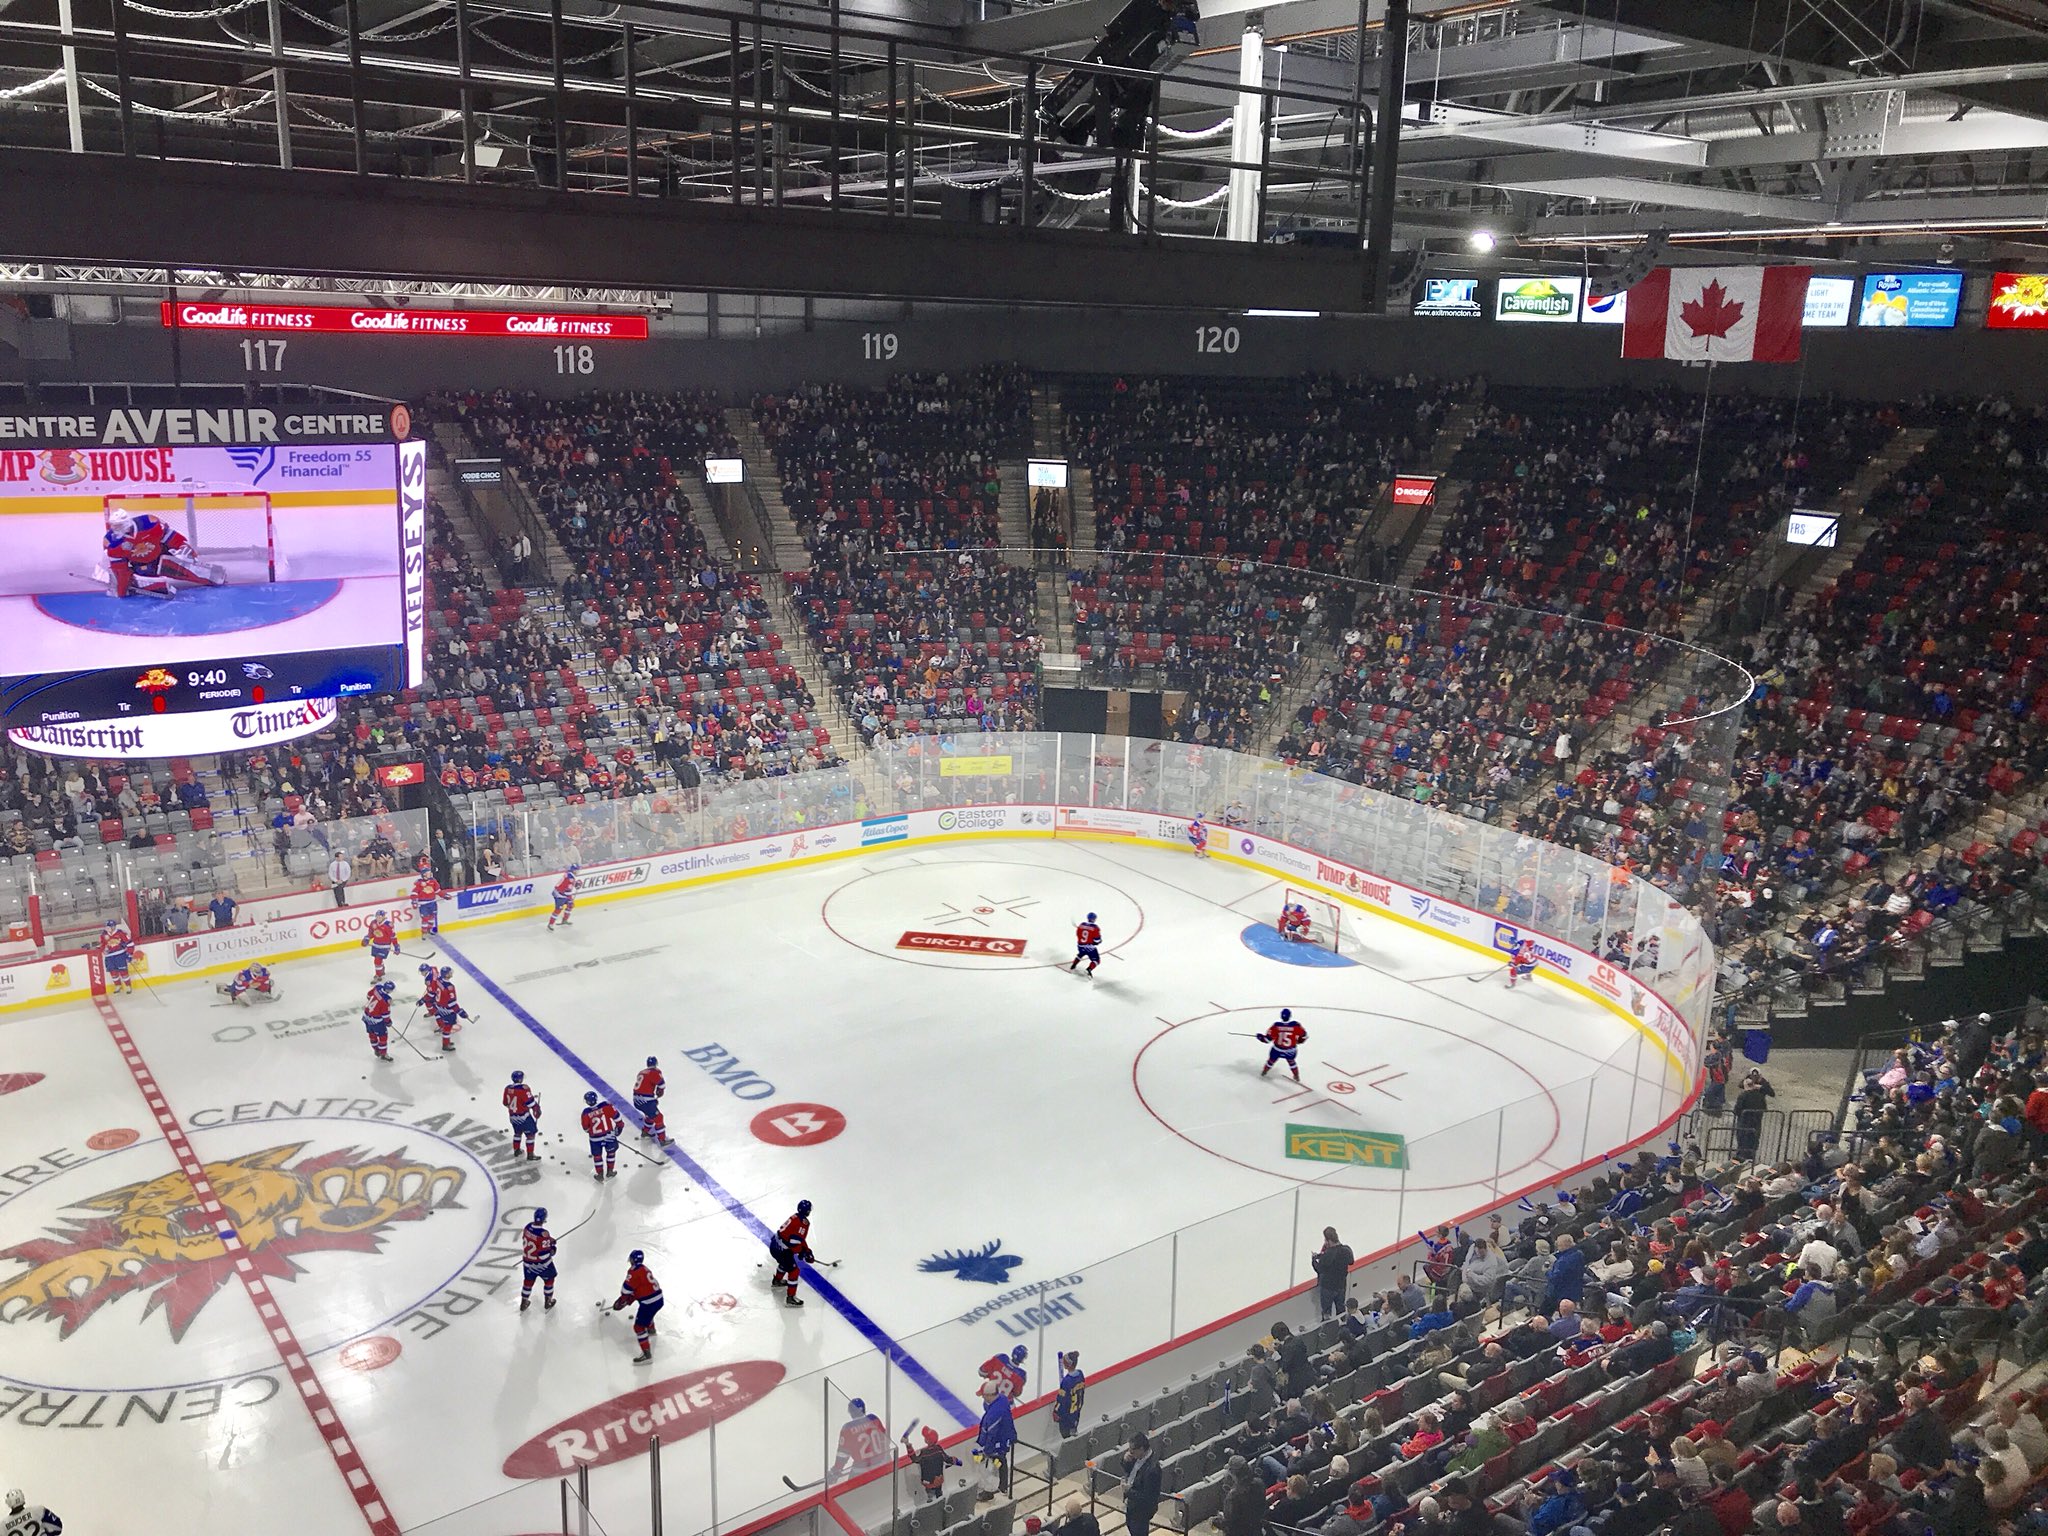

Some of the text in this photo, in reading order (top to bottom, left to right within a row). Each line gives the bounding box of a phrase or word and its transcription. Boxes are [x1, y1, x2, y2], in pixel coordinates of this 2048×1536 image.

[1810, 289, 1829, 297] LIGHT
[1877, 280, 1901, 290] Royale
[1413, 309, 1482, 318] www.exitmoncton.ca
[1505, 294, 1569, 312] Cavendish
[182, 306, 314, 328] GoodLife FITNESS
[350, 311, 468, 331] GoodLife FITNESS
[1818, 310, 1837, 319] TEAM
[506, 316, 612, 335] GoodLife FITNESS
[862, 332, 899, 360] 119
[1195, 326, 1241, 354] 120
[239, 338, 288, 371] 117
[553, 345, 595, 375] 118
[0, 408, 384, 445] ENTRE AVENIR CENTRE
[0, 447, 176, 484] MP HOUSE
[288, 449, 372, 463] Freedom 55
[280, 463, 344, 478] Financial
[1403, 488, 1432, 496] ROGER
[402, 451, 423, 632] KELSEYS
[187, 669, 227, 687] 9:40
[340, 683, 372, 692] Punition
[199, 688, 242, 700] PERIOD(E)
[290, 685, 302, 694] Tir
[41, 711, 80, 722] Punition
[117, 702, 131, 711] Tir
[957, 809, 1007, 820] Eastern
[815, 836, 837, 846] IRVING
[861, 823, 910, 839] Atlas Copco
[759, 846, 782, 857] IRVING
[1257, 845, 1312, 873] Grant Thornton
[660, 851, 751, 875] eastlink wireless
[471, 883, 534, 904] WINMAR
[1316, 860, 1346, 887] PUMP
[1361, 880, 1392, 906] HOUSE
[335, 907, 414, 934] ROGRS
[207, 928, 298, 953] LOUISBOURG
[910, 936, 982, 949] CIRCLE
[1546, 949, 1573, 969] PARTS
[91, 955, 102, 985] CCM
[1596, 964, 1617, 986] CR
[1277, 1031, 1293, 1047] 15
[681, 1042, 776, 1101] BMO
[591, 1114, 609, 1135] 21
[188, 1097, 416, 1128] CENTRE
[411, 1112, 542, 1192] AVENIR
[1290, 1134, 1400, 1166] KENT
[0, 1147, 89, 1190] RE
[958, 1274, 1085, 1327] MOOSEHEAD
[995, 1292, 1087, 1338] LIGHT
[857, 1428, 882, 1459] 20
